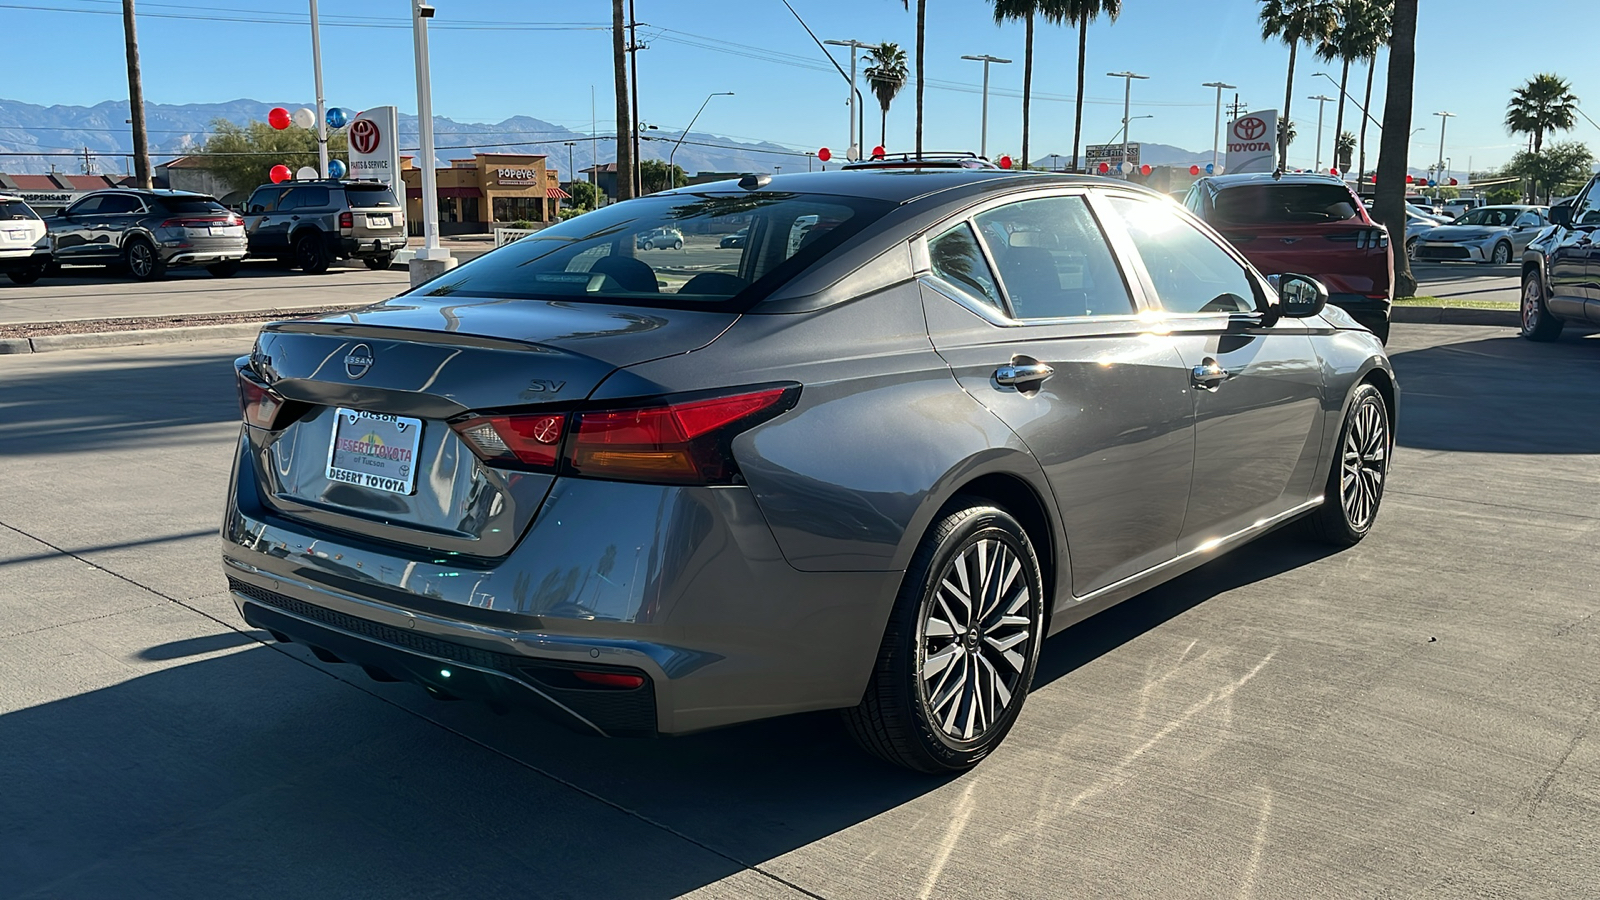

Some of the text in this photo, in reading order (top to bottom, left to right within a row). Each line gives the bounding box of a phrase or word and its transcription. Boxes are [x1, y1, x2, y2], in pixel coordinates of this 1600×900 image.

[1110, 149, 1138, 157] FITNSS
[1227, 142, 1271, 153] TOYOTA
[350, 161, 363, 170] PARTS
[368, 161, 388, 169] SERVICE
[529, 379, 567, 393] SV
[357, 411, 398, 423] TUCSON
[337, 437, 412, 462] DESERT TOYOTA
[362, 457, 385, 468] Tucson
[329, 468, 405, 493] DESERT TOYOTA
